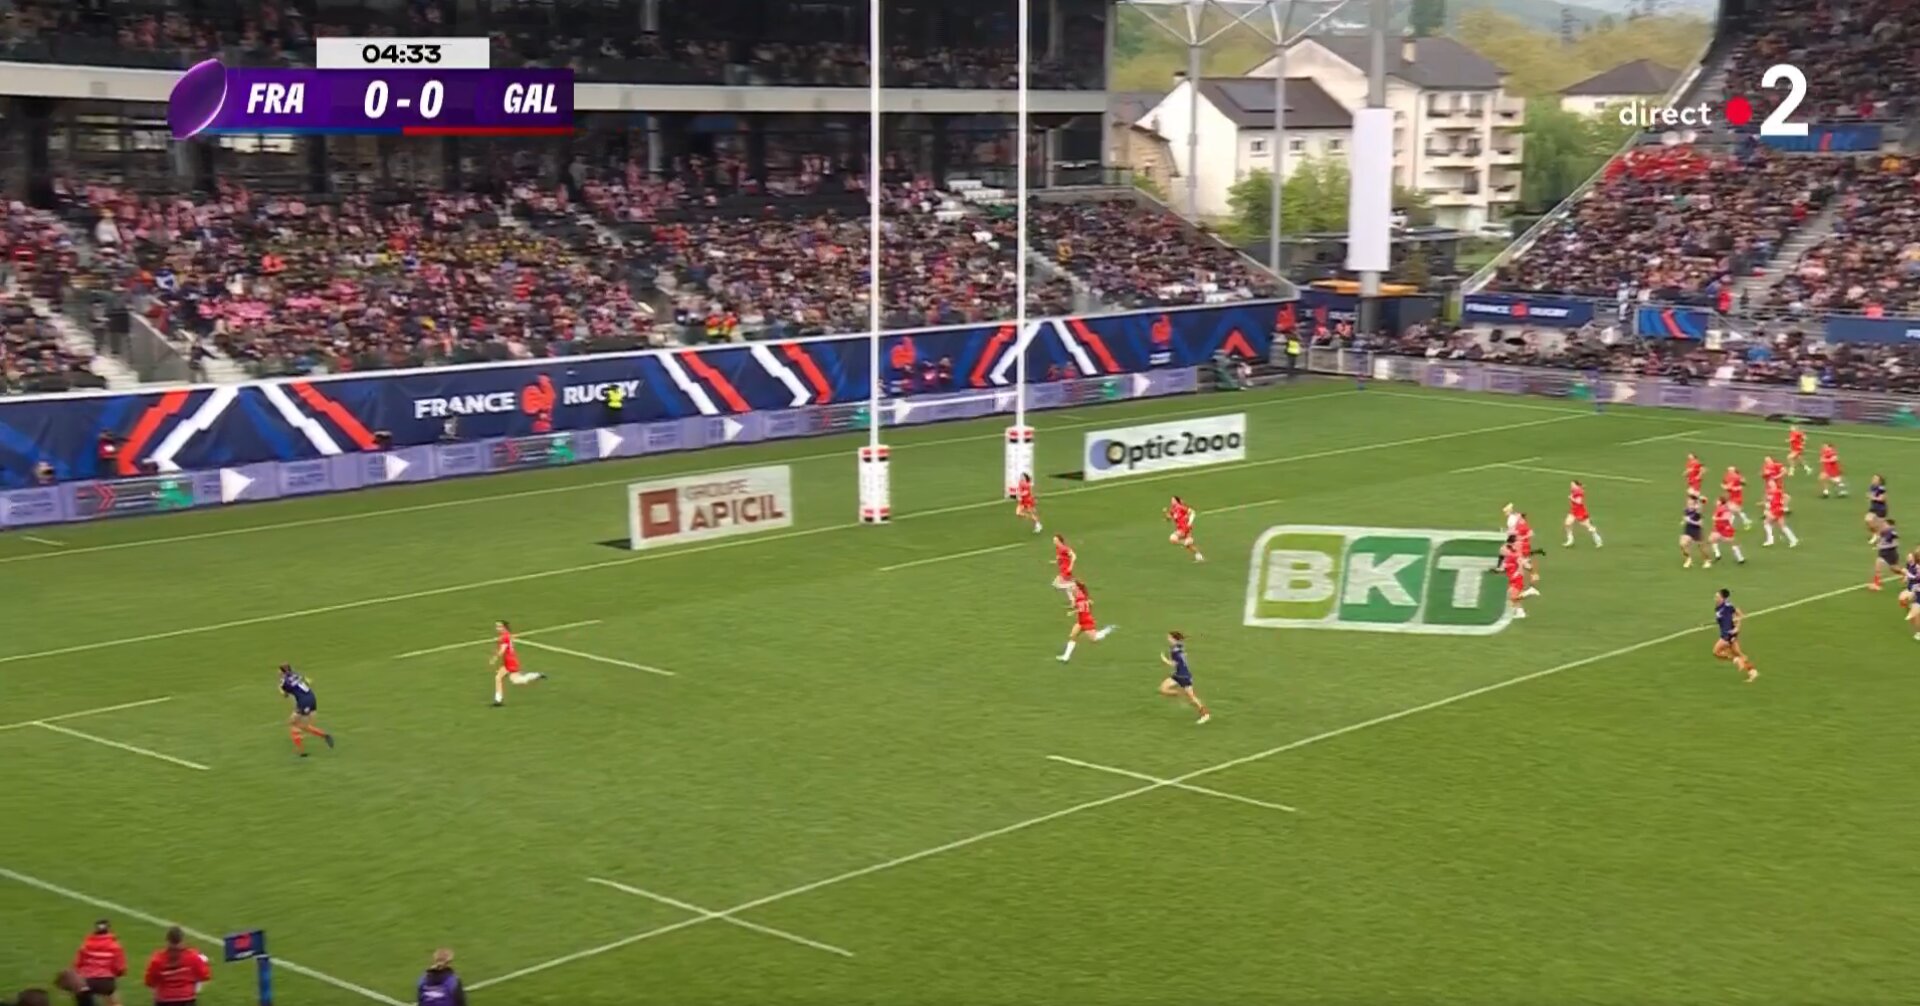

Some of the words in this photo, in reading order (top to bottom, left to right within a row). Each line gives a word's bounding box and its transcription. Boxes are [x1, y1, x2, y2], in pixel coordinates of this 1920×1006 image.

[414, 391, 516, 419] FRANCE
[563, 380, 640, 405] RUGY
[1106, 434, 1178, 470] Optic
[1181, 431, 1242, 456] 2000
[690, 493, 785, 530] APICIL
[1263, 549, 1502, 609] BKT
